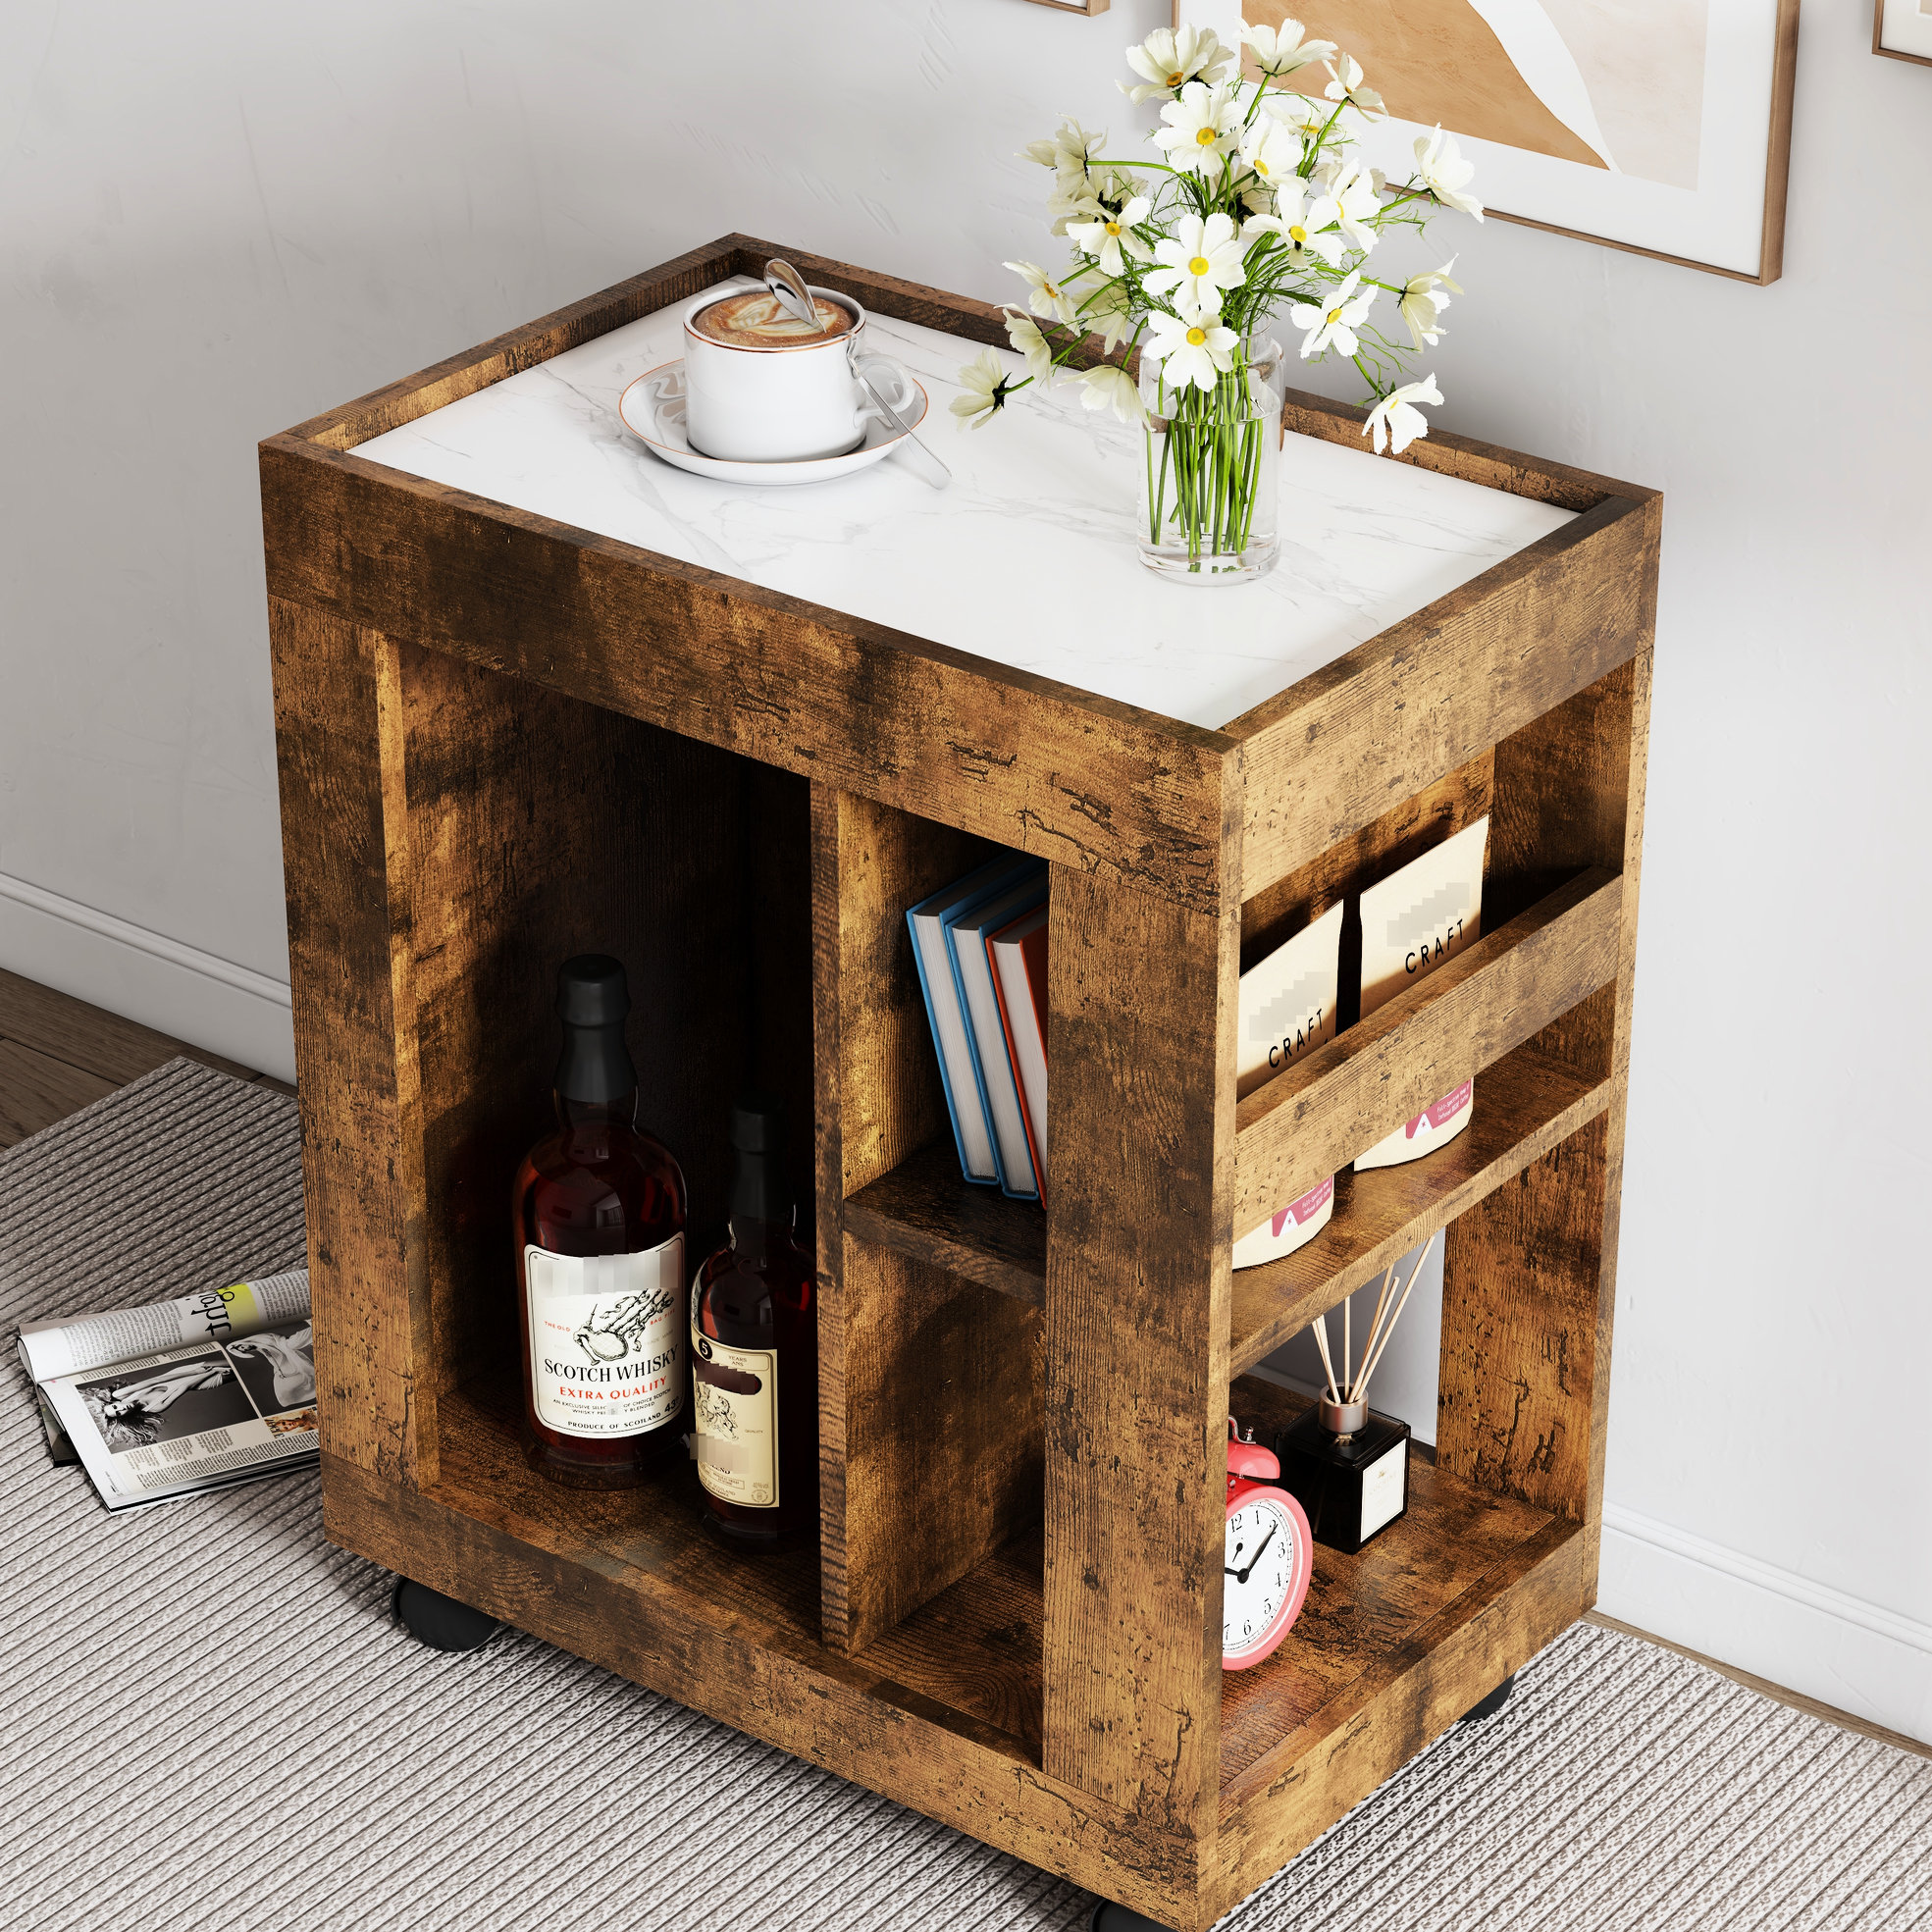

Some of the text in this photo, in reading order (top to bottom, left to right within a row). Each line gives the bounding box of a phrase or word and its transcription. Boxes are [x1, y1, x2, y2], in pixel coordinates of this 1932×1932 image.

[1405, 918, 1463, 974] CRAFT
[1268, 1008, 1322, 1069] CRAFT
[544, 1320, 555, 1329] THE
[650, 1316, 662, 1326] BAG
[701, 1342, 708, 1356] 5
[544, 1343, 679, 1383] SCOTCH WHISKY
[559, 1375, 667, 1400] EXTRA QUALITY
[561, 1401, 590, 1410] EXCLUSIVE
[632, 1396, 653, 1406] CHOICE
[653, 1387, 671, 1400] SCOTCH
[568, 1421, 604, 1430] PRODUCE
[623, 1412, 661, 1429] SCOTLAND
[1230, 1513, 1242, 1533] 12
[1255, 1509, 1260, 1525] 1
[1278, 1541, 1285, 1558] 3
[1275, 1572, 1281, 1588] 4
[1264, 1597, 1271, 1615] 5
[1224, 1623, 1230, 1641] 7
[1243, 1619, 1251, 1636] 6
